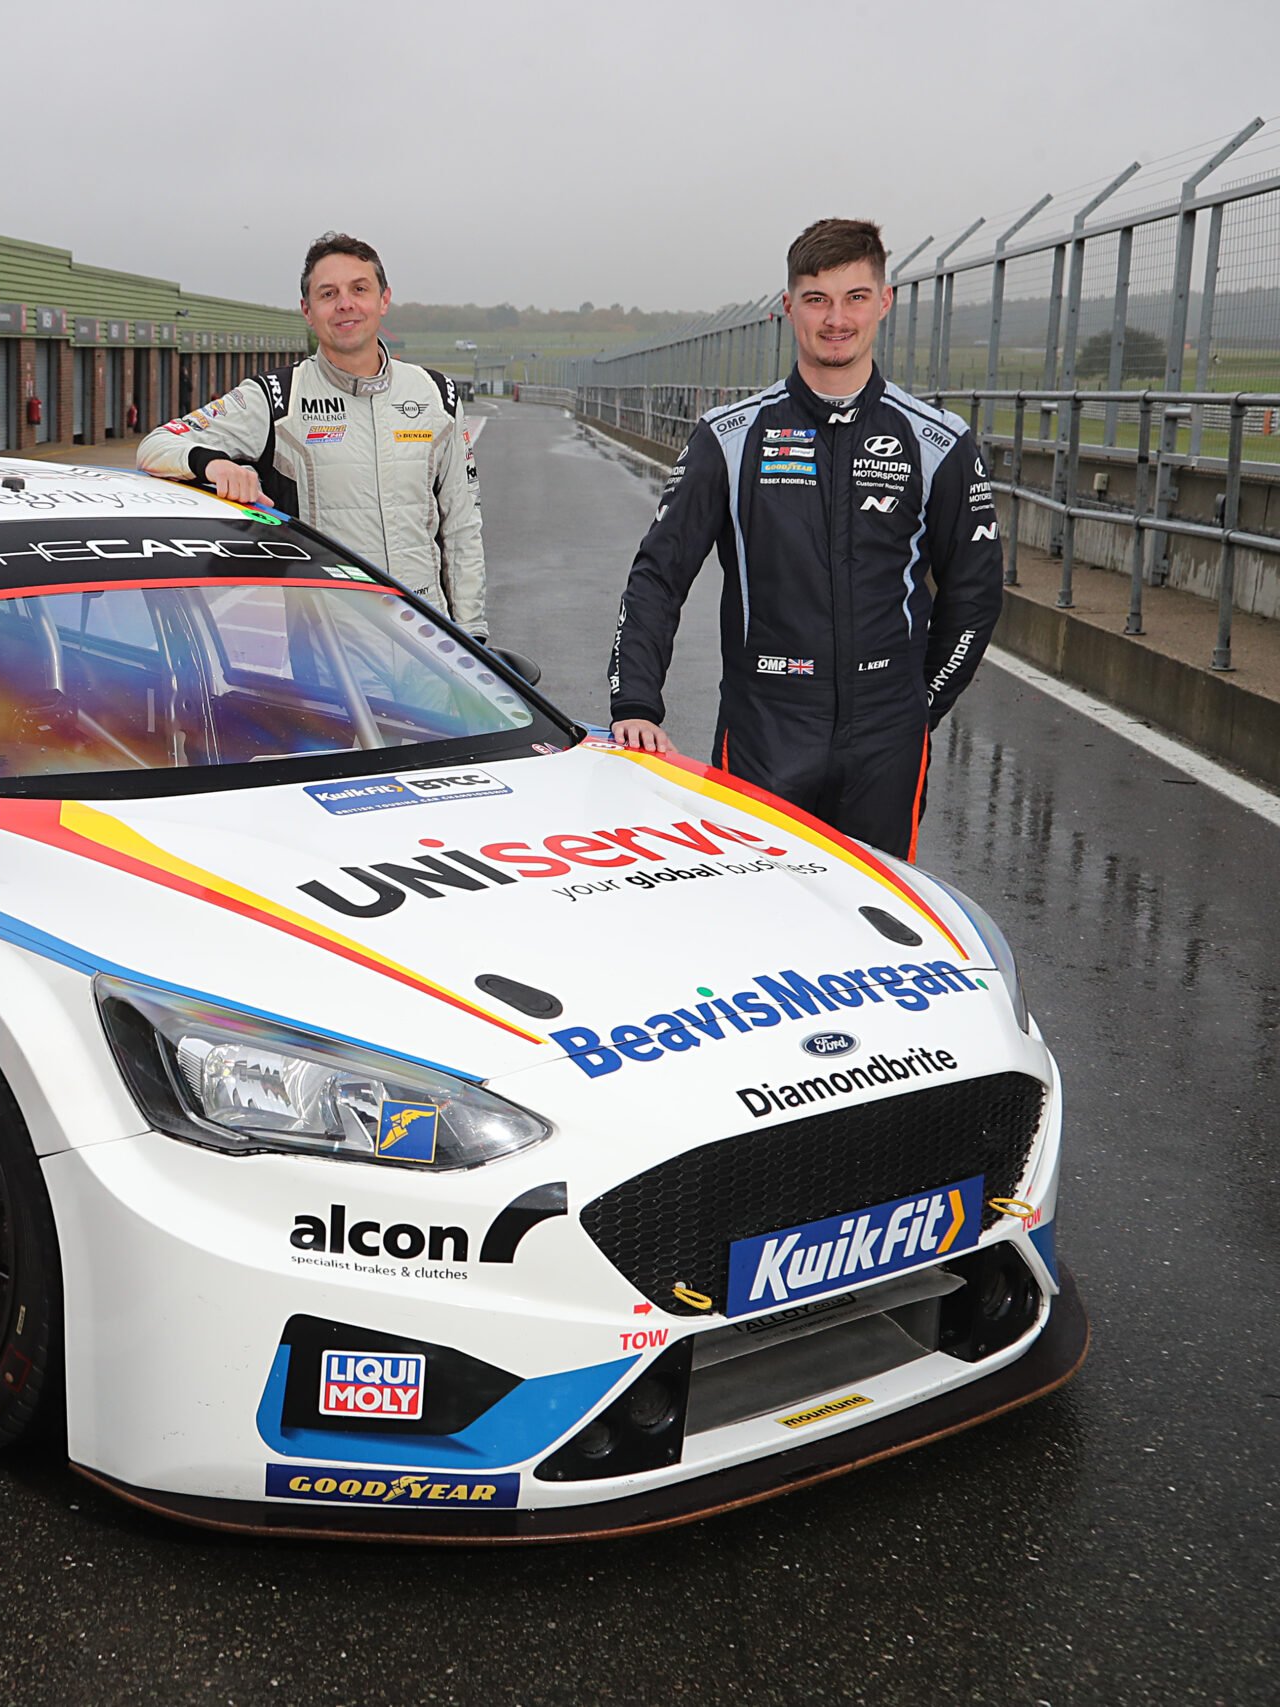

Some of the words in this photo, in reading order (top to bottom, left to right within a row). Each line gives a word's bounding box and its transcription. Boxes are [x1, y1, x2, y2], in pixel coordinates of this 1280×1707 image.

[266, 374, 285, 410] HRX
[301, 397, 346, 414] MINI
[302, 413, 347, 421] CHALLENGE
[716, 415, 747, 433] OMP
[764, 429, 792, 439] TCR
[922, 427, 952, 449] OMP
[762, 446, 791, 457] TCR
[852, 470, 910, 483] MOTORSPORT
[853, 459, 912, 474] HYUNDAI
[805, 478, 817, 486] LTD
[856, 480, 885, 488] Customer
[885, 482, 905, 492] Racing
[757, 657, 787, 671] OMP
[868, 658, 890, 670] KENT
[930, 629, 976, 692] HYUNDAI
[314, 783, 395, 803] KwikFit
[406, 774, 491, 791] BTCC
[335, 804, 376, 816] BRITISH
[377, 799, 419, 809] TOURING
[420, 795, 441, 803] CAR
[551, 876, 621, 903] your
[625, 862, 723, 890] global
[725, 855, 828, 878] business
[814, 1035, 849, 1053] Ford
[736, 1045, 958, 1118] Diamondbrite
[1021, 1206, 1042, 1232] TOW
[289, 1203, 469, 1263] alcon
[749, 1193, 945, 1302] KwikFit
[291, 1254, 351, 1271] specialist
[354, 1262, 397, 1277] brakes
[401, 1266, 411, 1278] &
[414, 1266, 468, 1280] clutches
[620, 1327, 669, 1351] TOW
[328, 1355, 418, 1385] LIQUI
[327, 1384, 418, 1415] MOLY
[783, 1395, 866, 1427] mountune
[288, 1476, 497, 1502] GOODYEAR
